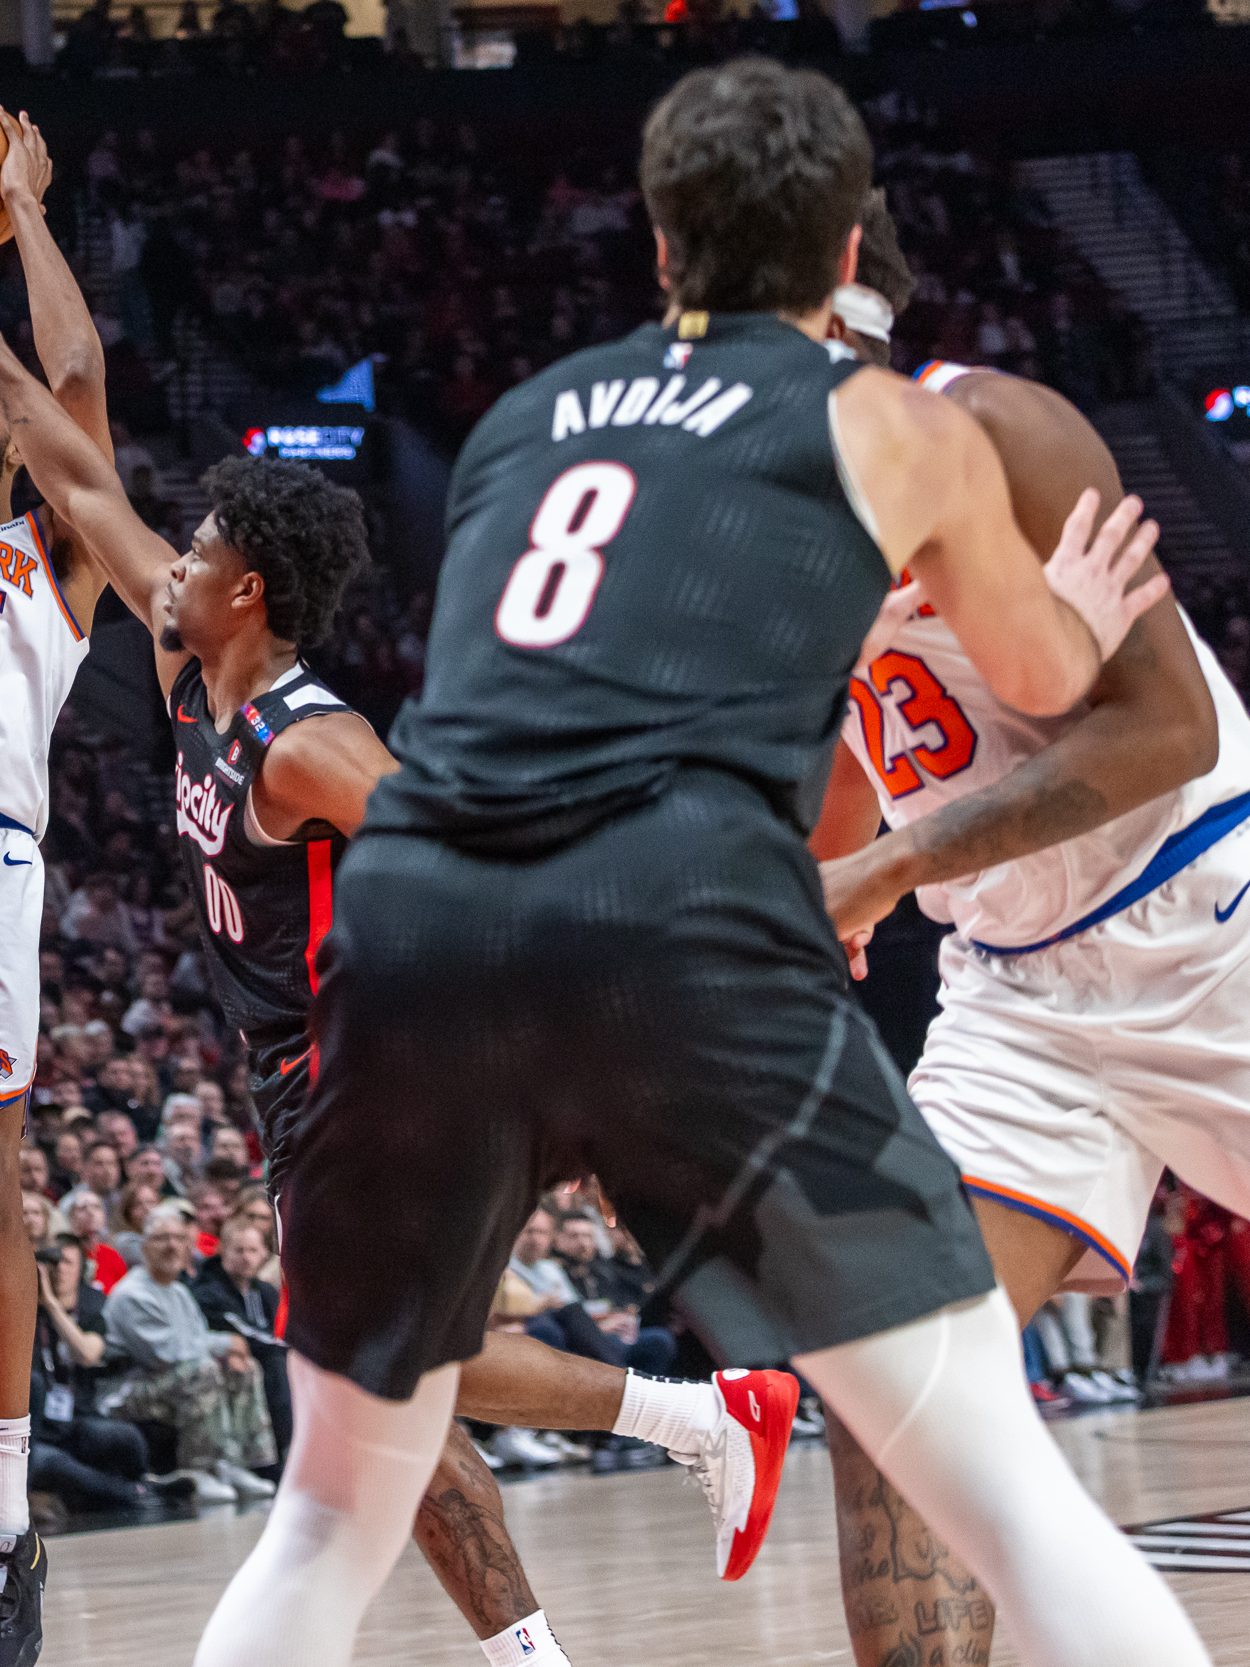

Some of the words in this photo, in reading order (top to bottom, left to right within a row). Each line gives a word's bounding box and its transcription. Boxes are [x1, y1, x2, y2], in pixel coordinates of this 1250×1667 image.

[551, 374, 753, 442] AVDIJA
[493, 459, 638, 650] 8
[251, 715, 266, 732] 32
[849, 648, 978, 801] 23
[175, 750, 235, 857] ipcity
[204, 863, 244, 944] 00
